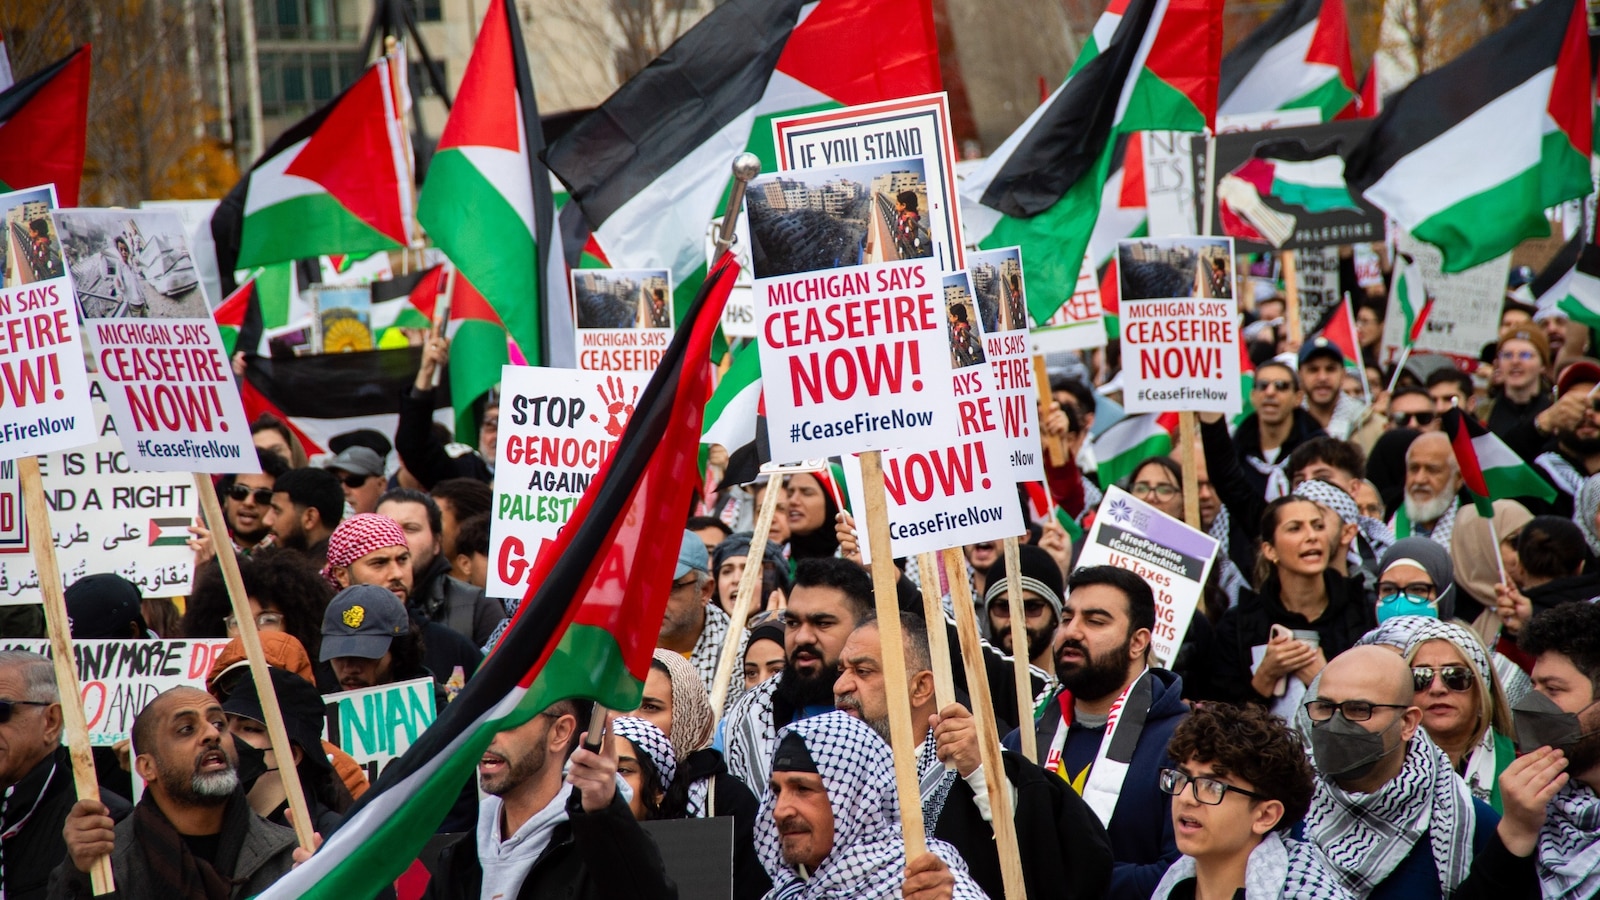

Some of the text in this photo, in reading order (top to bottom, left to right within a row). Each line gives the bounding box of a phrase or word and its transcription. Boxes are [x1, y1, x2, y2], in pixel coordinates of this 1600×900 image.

[800, 127, 923, 168] IF YOU STAND
[1295, 222, 1373, 242] PALESTINE
[16, 285, 60, 313] SAYS
[767, 265, 925, 307] MICHIGAN SAYS
[764, 293, 938, 349] CEASEFIRE
[1129, 302, 1228, 318] MICHIGAN SAYS
[97, 324, 211, 345] MICHIGAN SAYS
[583, 332, 667, 346] MICHIGAN SAYS
[1004, 334, 1026, 355] SAYS
[1125, 320, 1233, 344] CEASEFIRE
[100, 347, 228, 382] CEASEFIRE
[788, 339, 924, 407] NOW!
[1140, 347, 1223, 380] NOW!
[952, 371, 983, 397] AYS
[1137, 386, 1228, 401] #CeaseFireNow
[123, 383, 229, 433] NOW!
[511, 394, 586, 429] STOP
[789, 408, 934, 444] #CeaseFireNow
[63, 452, 86, 475] IS
[137, 439, 241, 459] #CeaseFireNow
[882, 440, 992, 507] NOW!
[82, 488, 103, 511] A
[112, 484, 192, 510] RIGHT
[889, 506, 1003, 541] CeaseFireNow
[1109, 539, 1188, 576] #GazaUnderAttack
[1119, 531, 1183, 563] #FreePalestine
[1108, 552, 1172, 587] US Taxes
[1158, 589, 1174, 605] to
[74, 641, 187, 682] ANYMORE
